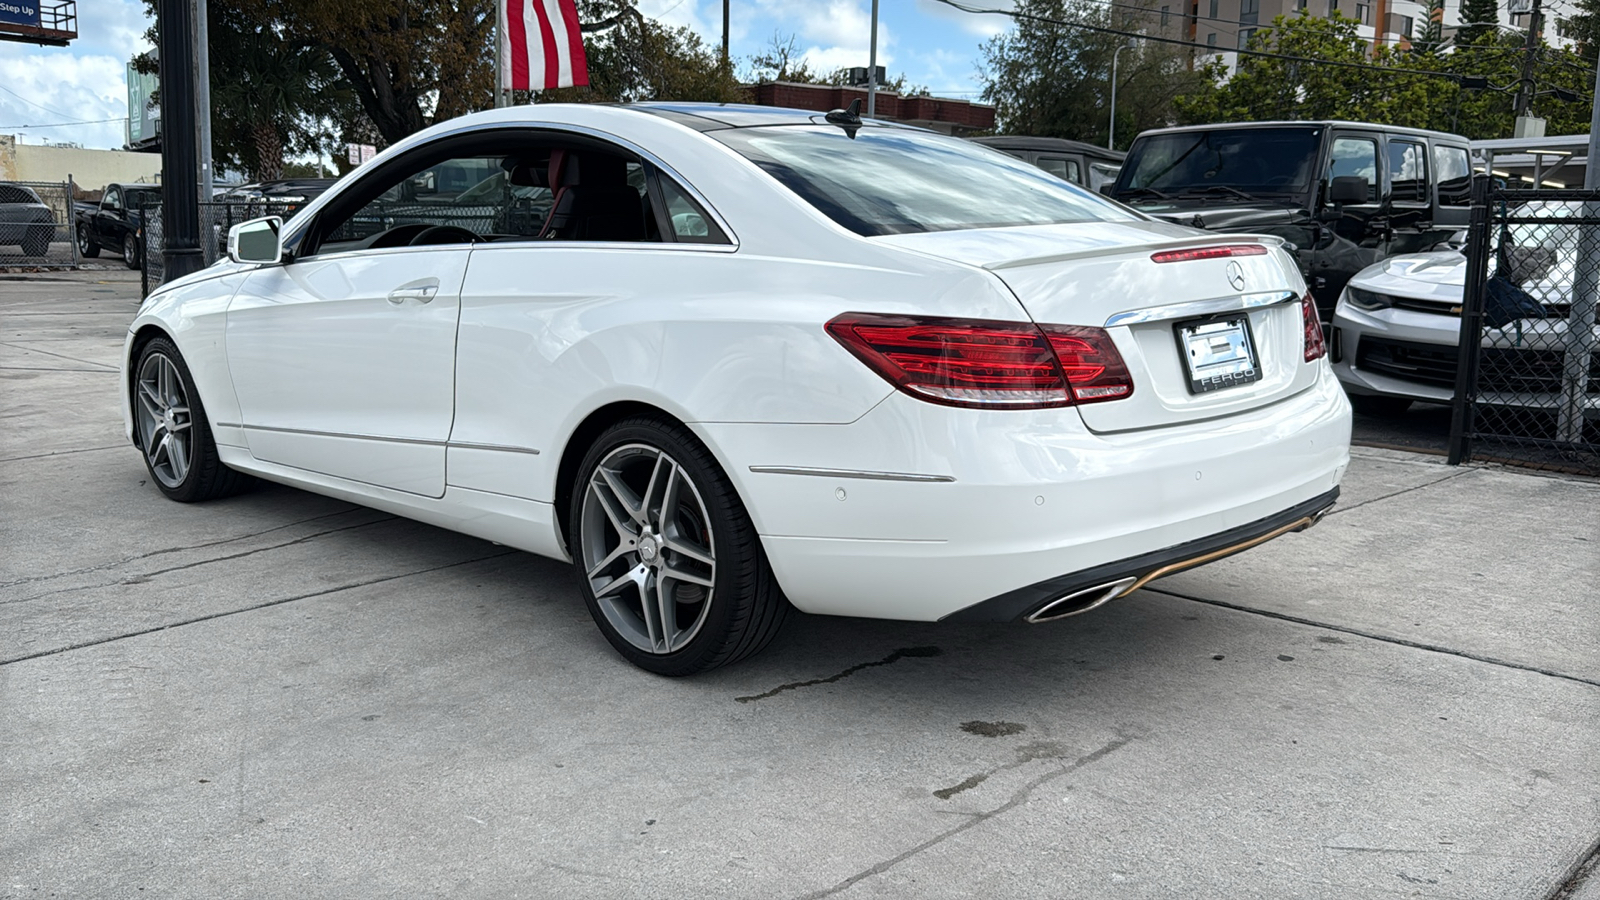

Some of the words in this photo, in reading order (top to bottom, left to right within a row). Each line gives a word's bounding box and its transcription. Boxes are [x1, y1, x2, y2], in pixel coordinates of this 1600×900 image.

[0, 3, 20, 14] Step
[21, 6, 34, 16] Up
[1201, 369, 1255, 386] FERCO
